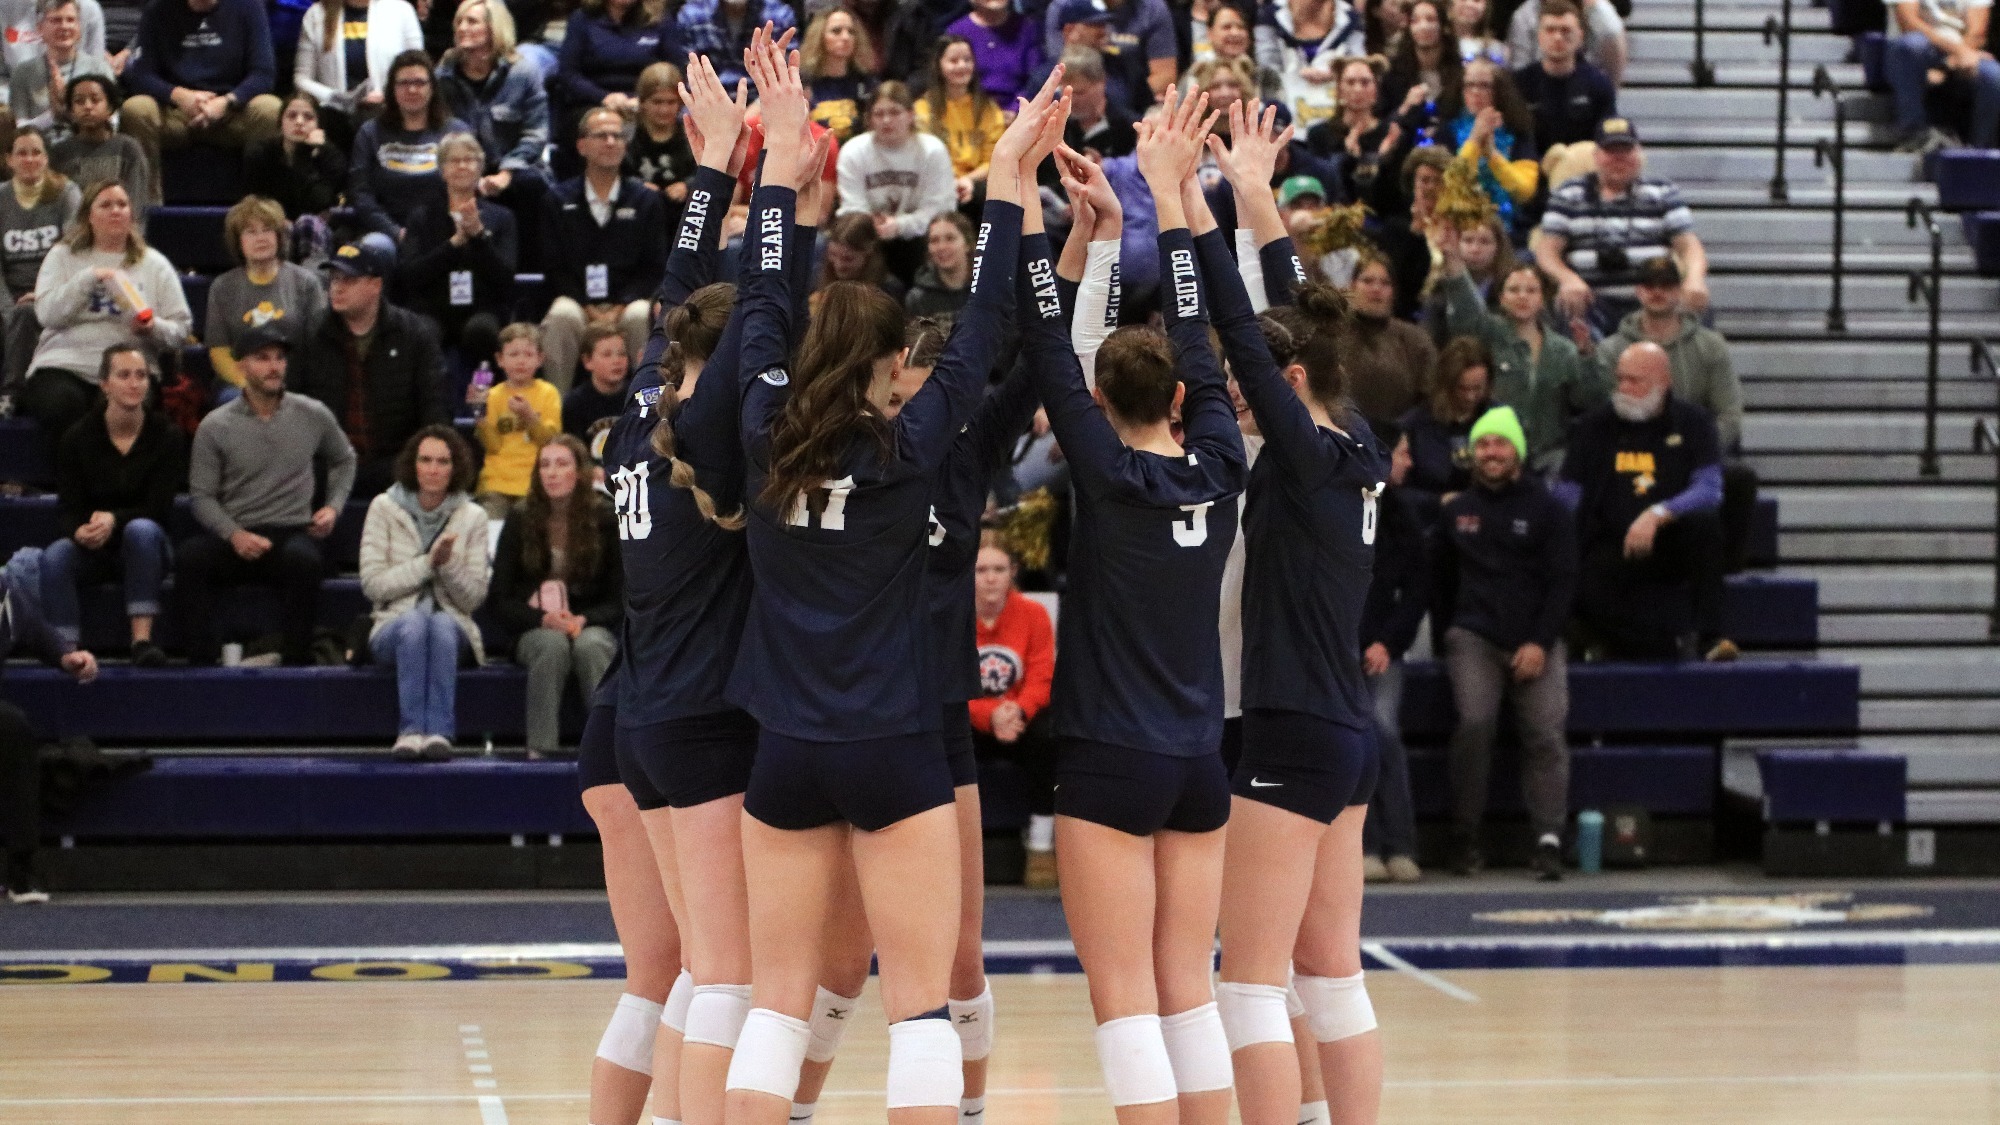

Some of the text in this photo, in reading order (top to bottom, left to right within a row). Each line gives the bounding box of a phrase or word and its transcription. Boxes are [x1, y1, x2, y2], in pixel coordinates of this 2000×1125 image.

[678, 190, 711, 251] BEARS
[761, 207, 783, 271] BEARS
[1170, 249, 1199, 318] GOLDEN
[611, 461, 652, 541] 20
